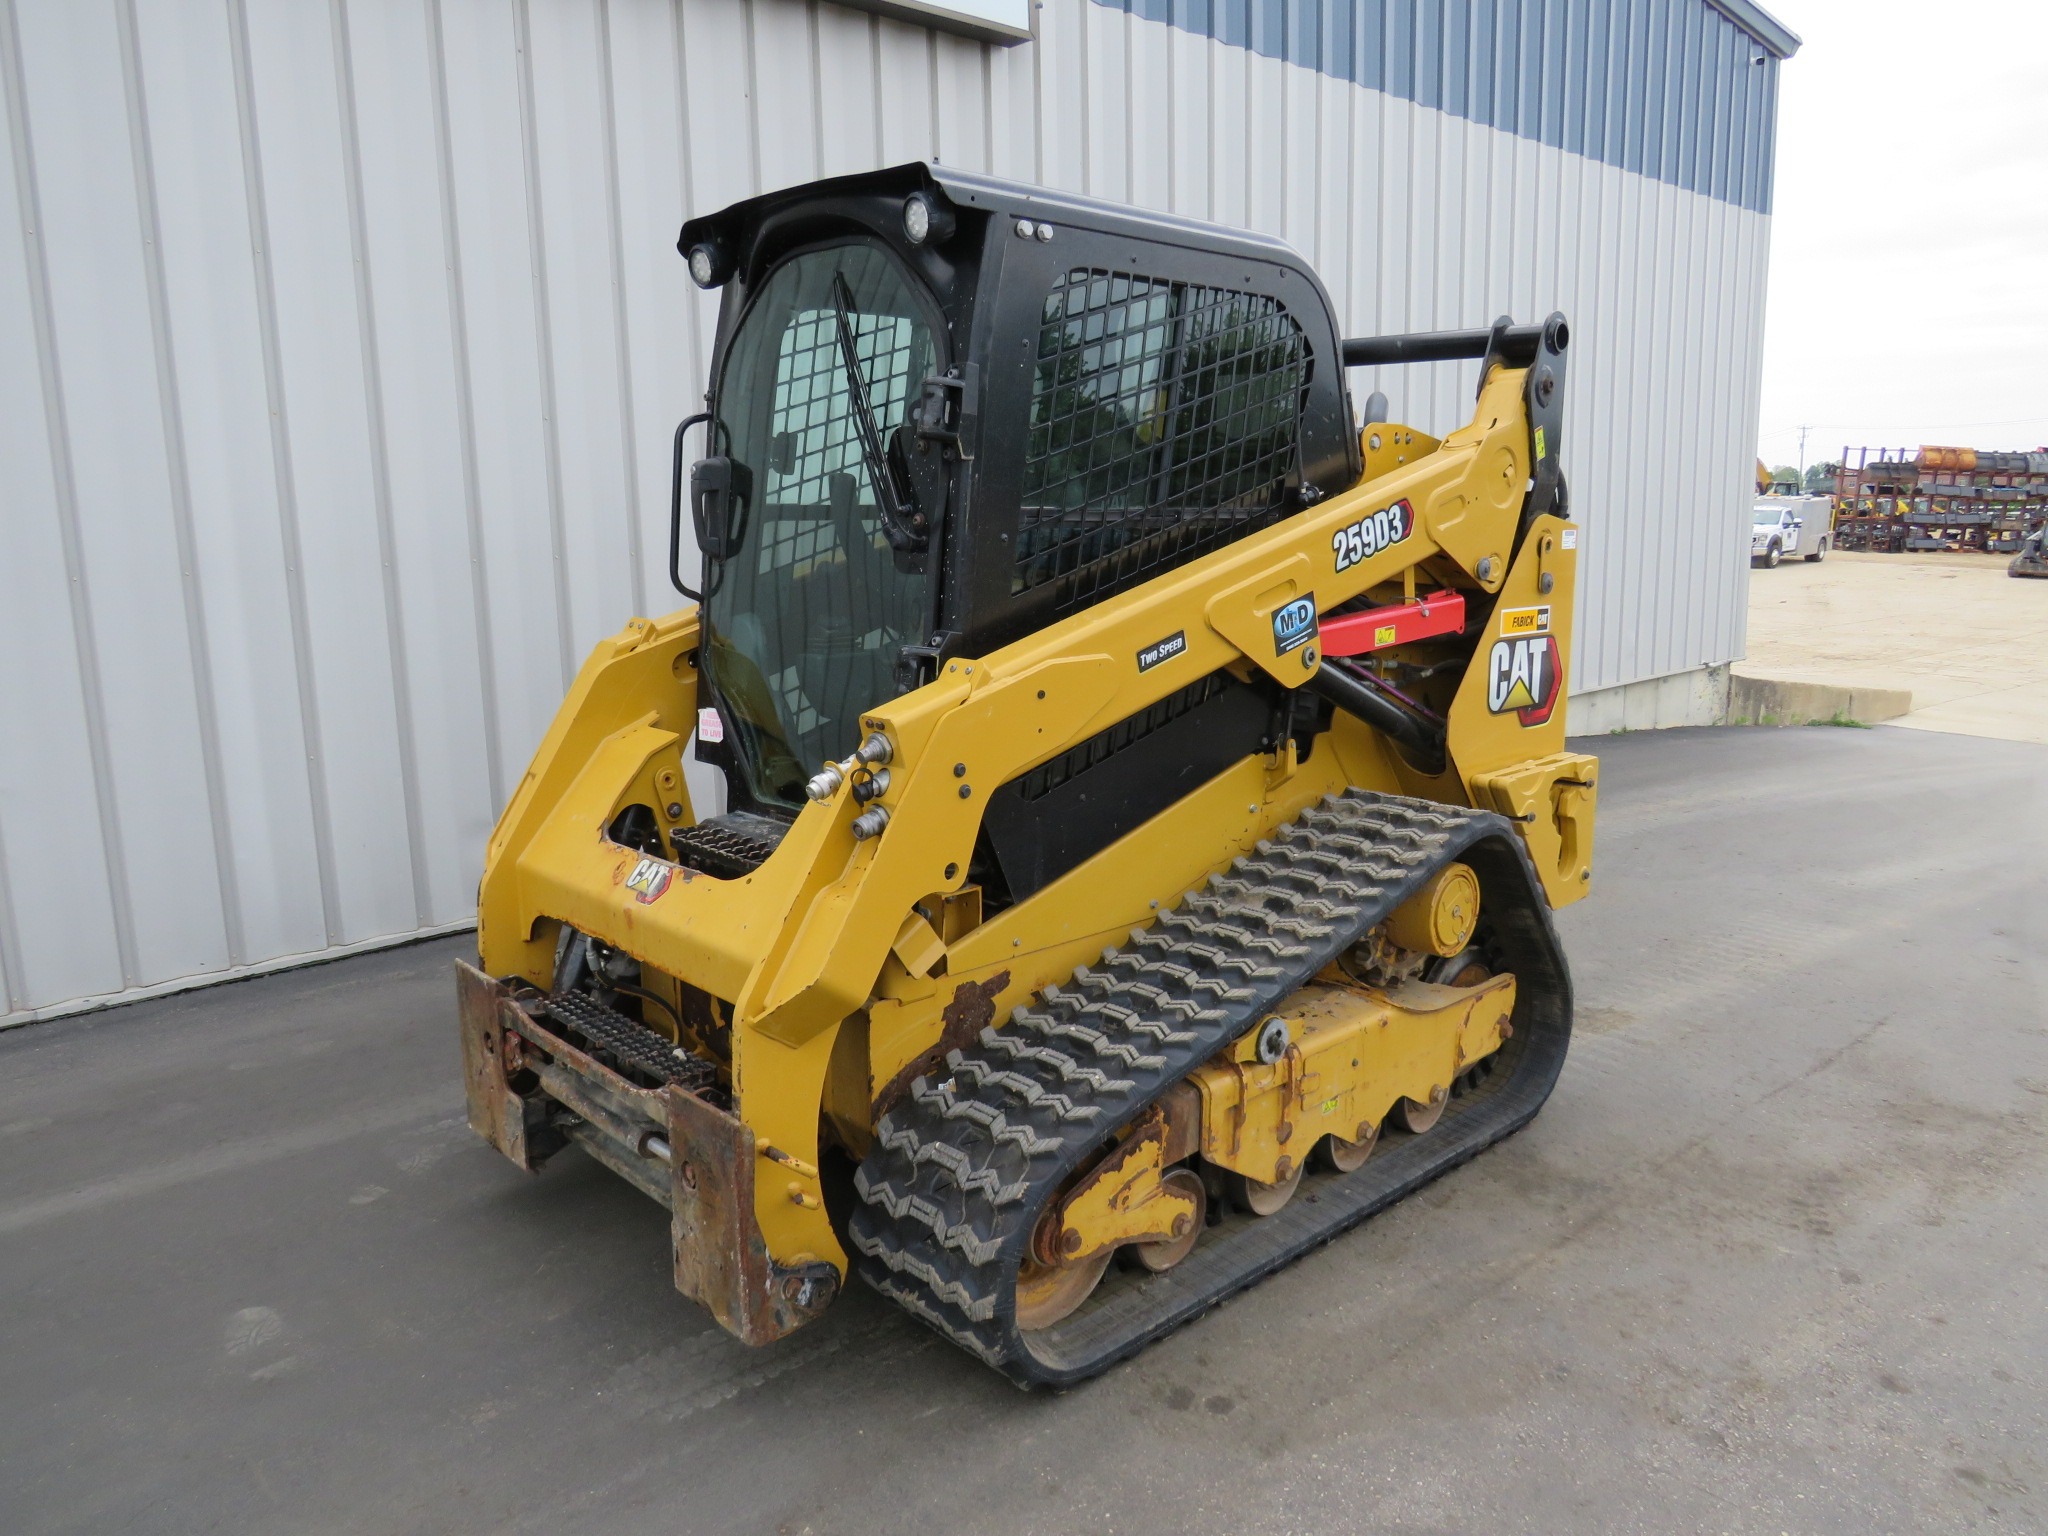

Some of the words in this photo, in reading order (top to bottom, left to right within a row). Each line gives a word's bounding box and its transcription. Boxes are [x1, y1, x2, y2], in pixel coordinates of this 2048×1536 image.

[1333, 504, 1403, 571] 259D3
[1512, 615, 1535, 628] FABICK
[1489, 637, 1548, 712] CAT
[702, 729, 709, 737] TO
[710, 730, 722, 738] LIVE
[627, 859, 670, 898] CAT
